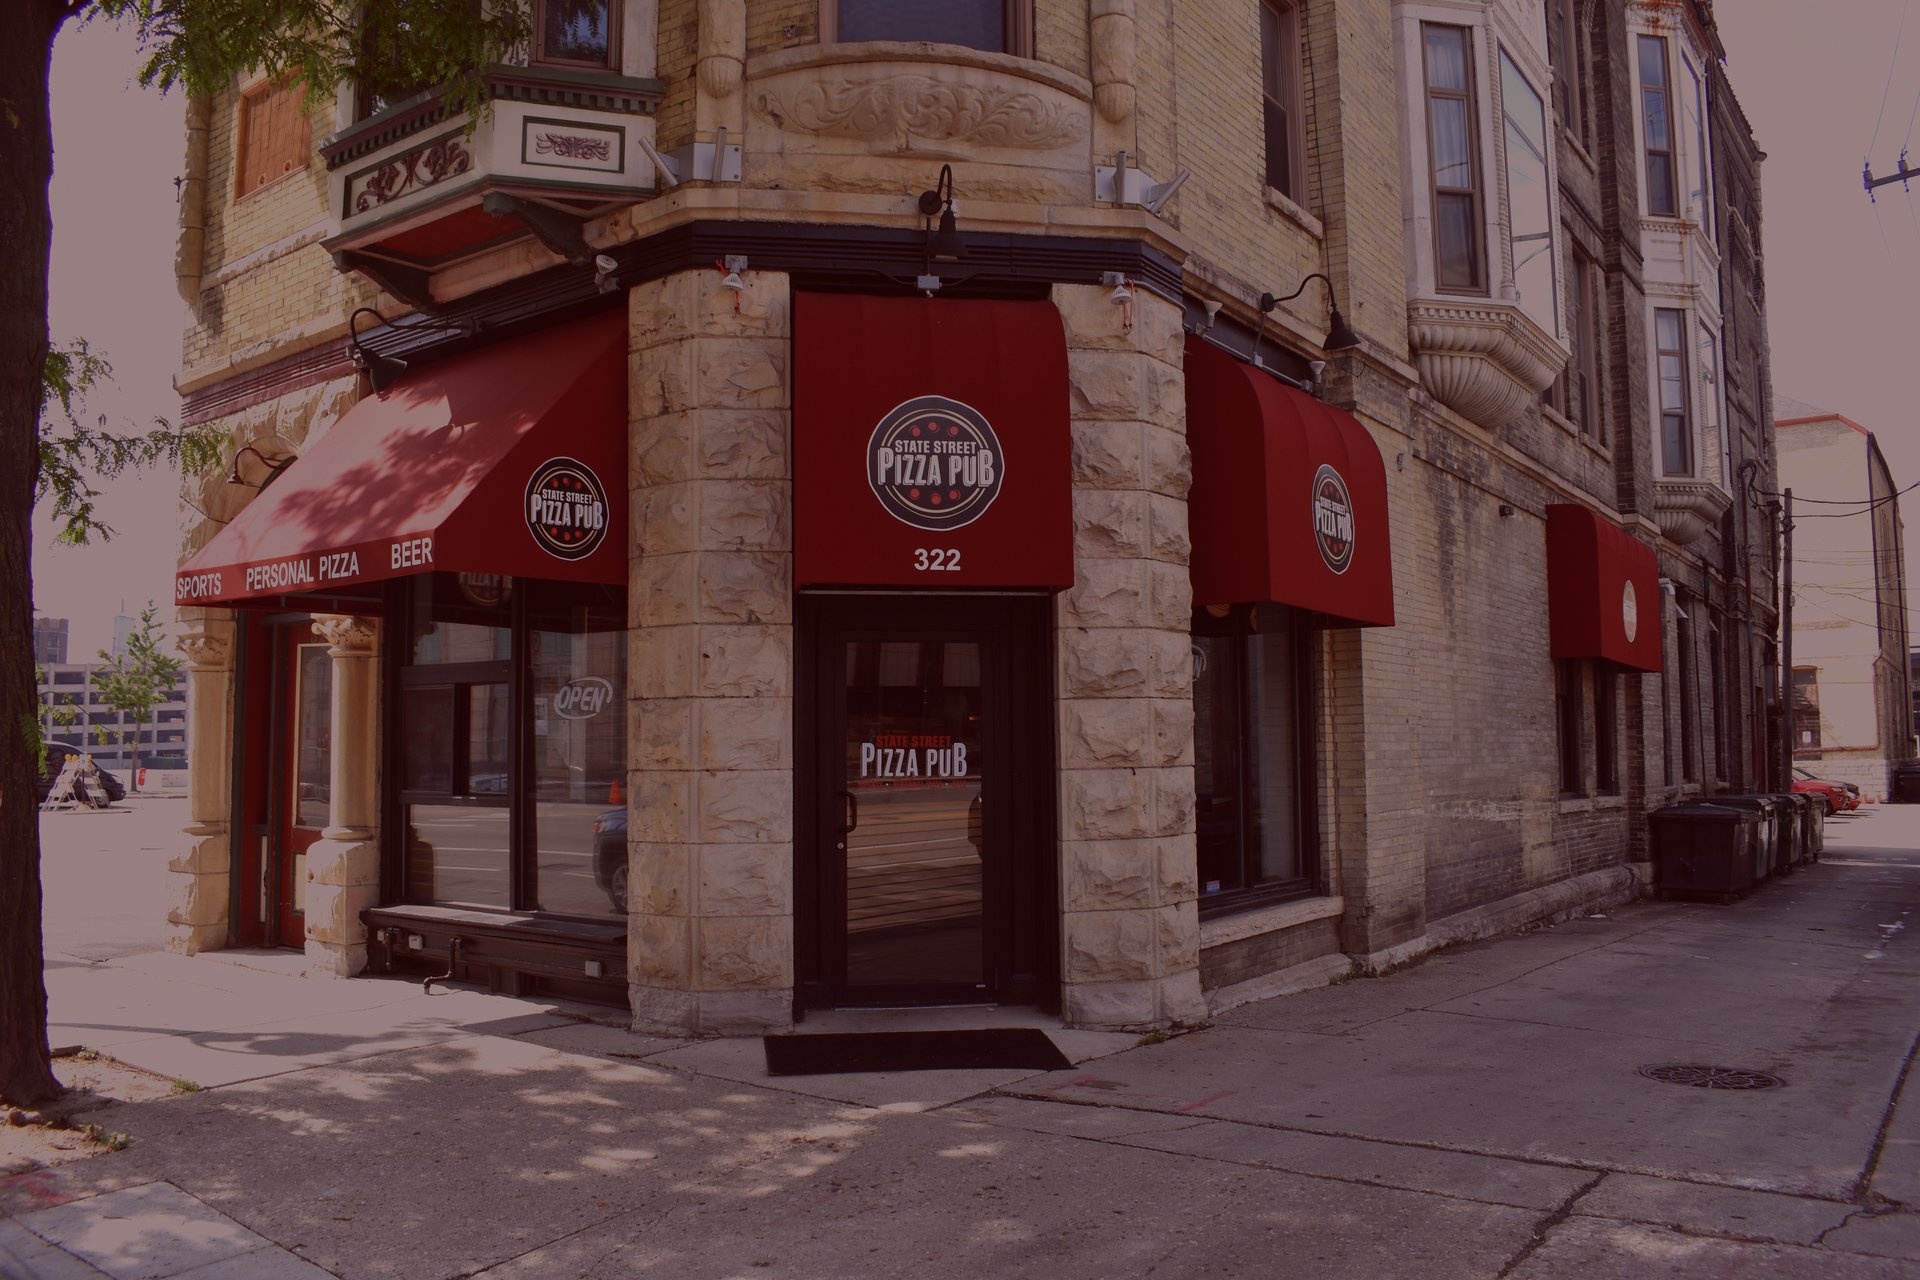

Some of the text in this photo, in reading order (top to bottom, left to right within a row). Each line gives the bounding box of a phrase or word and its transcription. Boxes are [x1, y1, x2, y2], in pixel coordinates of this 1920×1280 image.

[895, 439, 977, 454] STATE STREET
[877, 447, 995, 487] PIZZA PUB
[530, 493, 604, 530] PIZZA PUB
[542, 488, 593, 504] STATE STREET
[1314, 500, 1352, 543] PIZZA PUB
[176, 537, 433, 599] SPORTS PERSONAL PIZZA BEER
[913, 548, 962, 571] 322
[558, 685, 607, 713] OPEN
[875, 735, 952, 748] STATE STREET
[860, 742, 968, 777] PIZZA PUB
